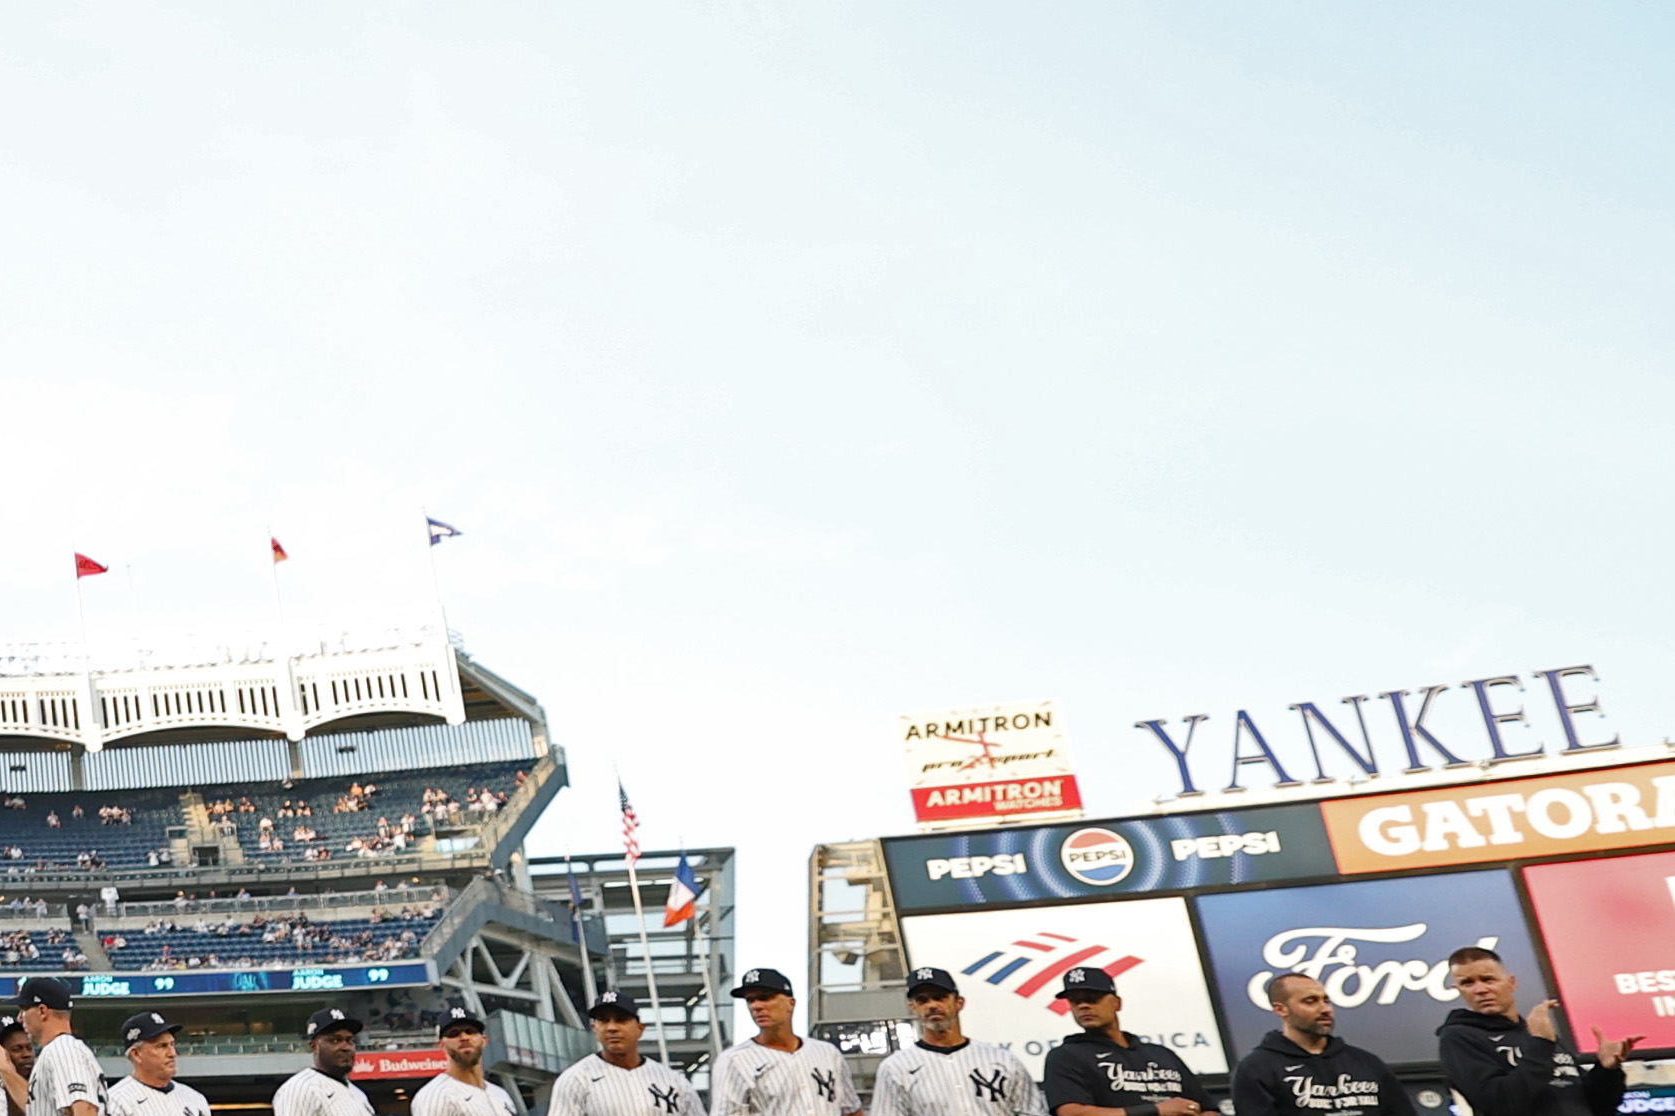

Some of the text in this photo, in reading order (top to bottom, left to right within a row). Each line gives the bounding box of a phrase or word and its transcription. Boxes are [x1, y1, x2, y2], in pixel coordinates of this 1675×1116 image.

[906, 712, 1052, 741] ARMITRON
[1134, 665, 1621, 796] YANKEE
[922, 760, 963, 773] pro
[927, 780, 1062, 807] ARMITRON
[994, 796, 1063, 811] WATCHES
[1358, 775, 1675, 856] GATOR
[1069, 849, 1126, 863] PEPSI
[1170, 831, 1282, 861] PEPSI
[926, 853, 1027, 880] PEPSI
[291, 968, 389, 990] JUDGE 99
[292, 969, 324, 977] AARON
[1614, 970, 1675, 994] BES
[82, 977, 175, 996] JUDGE 99
[1138, 1033, 1210, 1049] RICA
[379, 1057, 448, 1073] Budweise
[1098, 1061, 1182, 1092] Yankees
[969, 1068, 1008, 1101] NY
[1283, 1073, 1379, 1108] Yankees
[648, 1083, 679, 1114] NY
[1617, 1097, 1675, 1113] UDGE
